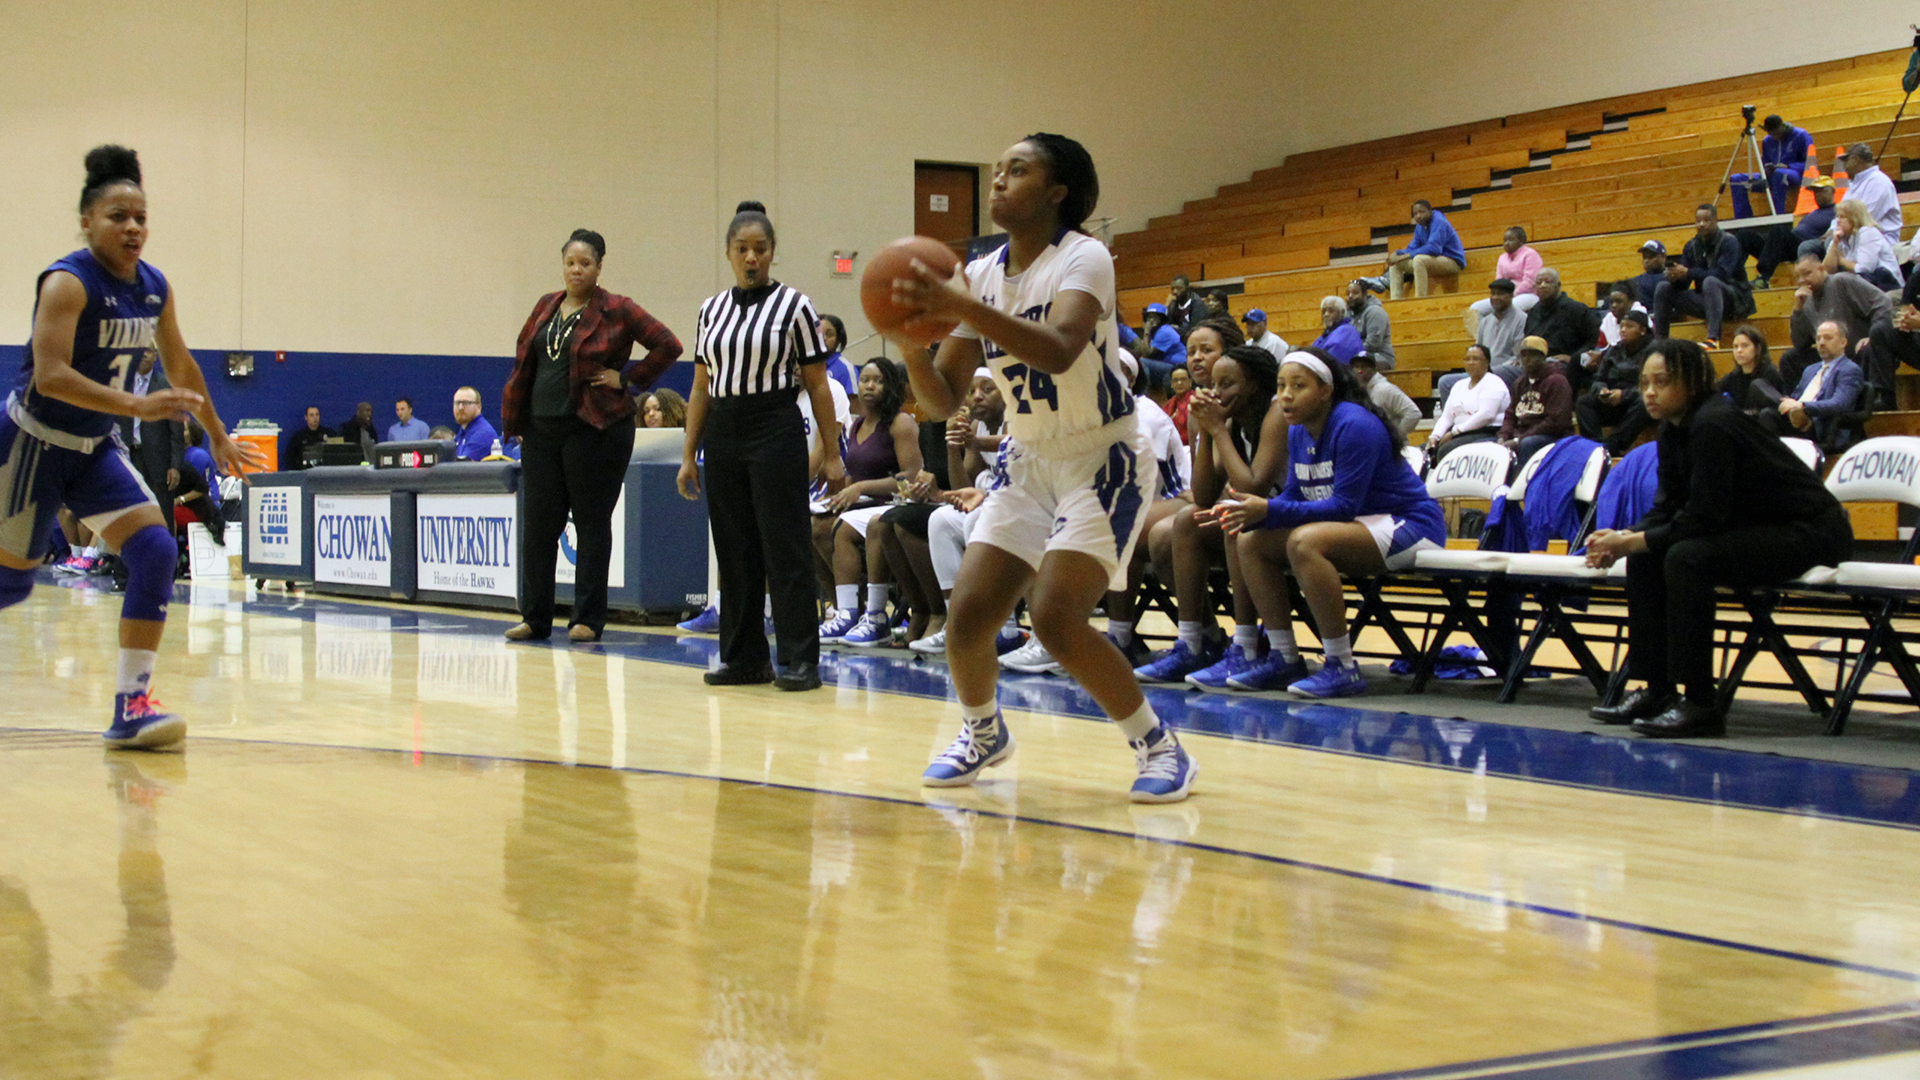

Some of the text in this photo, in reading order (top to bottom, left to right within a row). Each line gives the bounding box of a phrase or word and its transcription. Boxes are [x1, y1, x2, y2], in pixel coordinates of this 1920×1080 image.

[1002, 362, 1059, 414] 24
[1436, 454, 1499, 486] CHOWAN
[1837, 450, 1920, 487] CHOWAN
[317, 514, 391, 561] CHOWAN
[420, 515, 513, 567] UNIVERSITY
[433, 571, 451, 585] Home
[452, 572, 459, 586] of
[459, 572, 469, 587] the
[685, 593, 708, 601] FISHER
